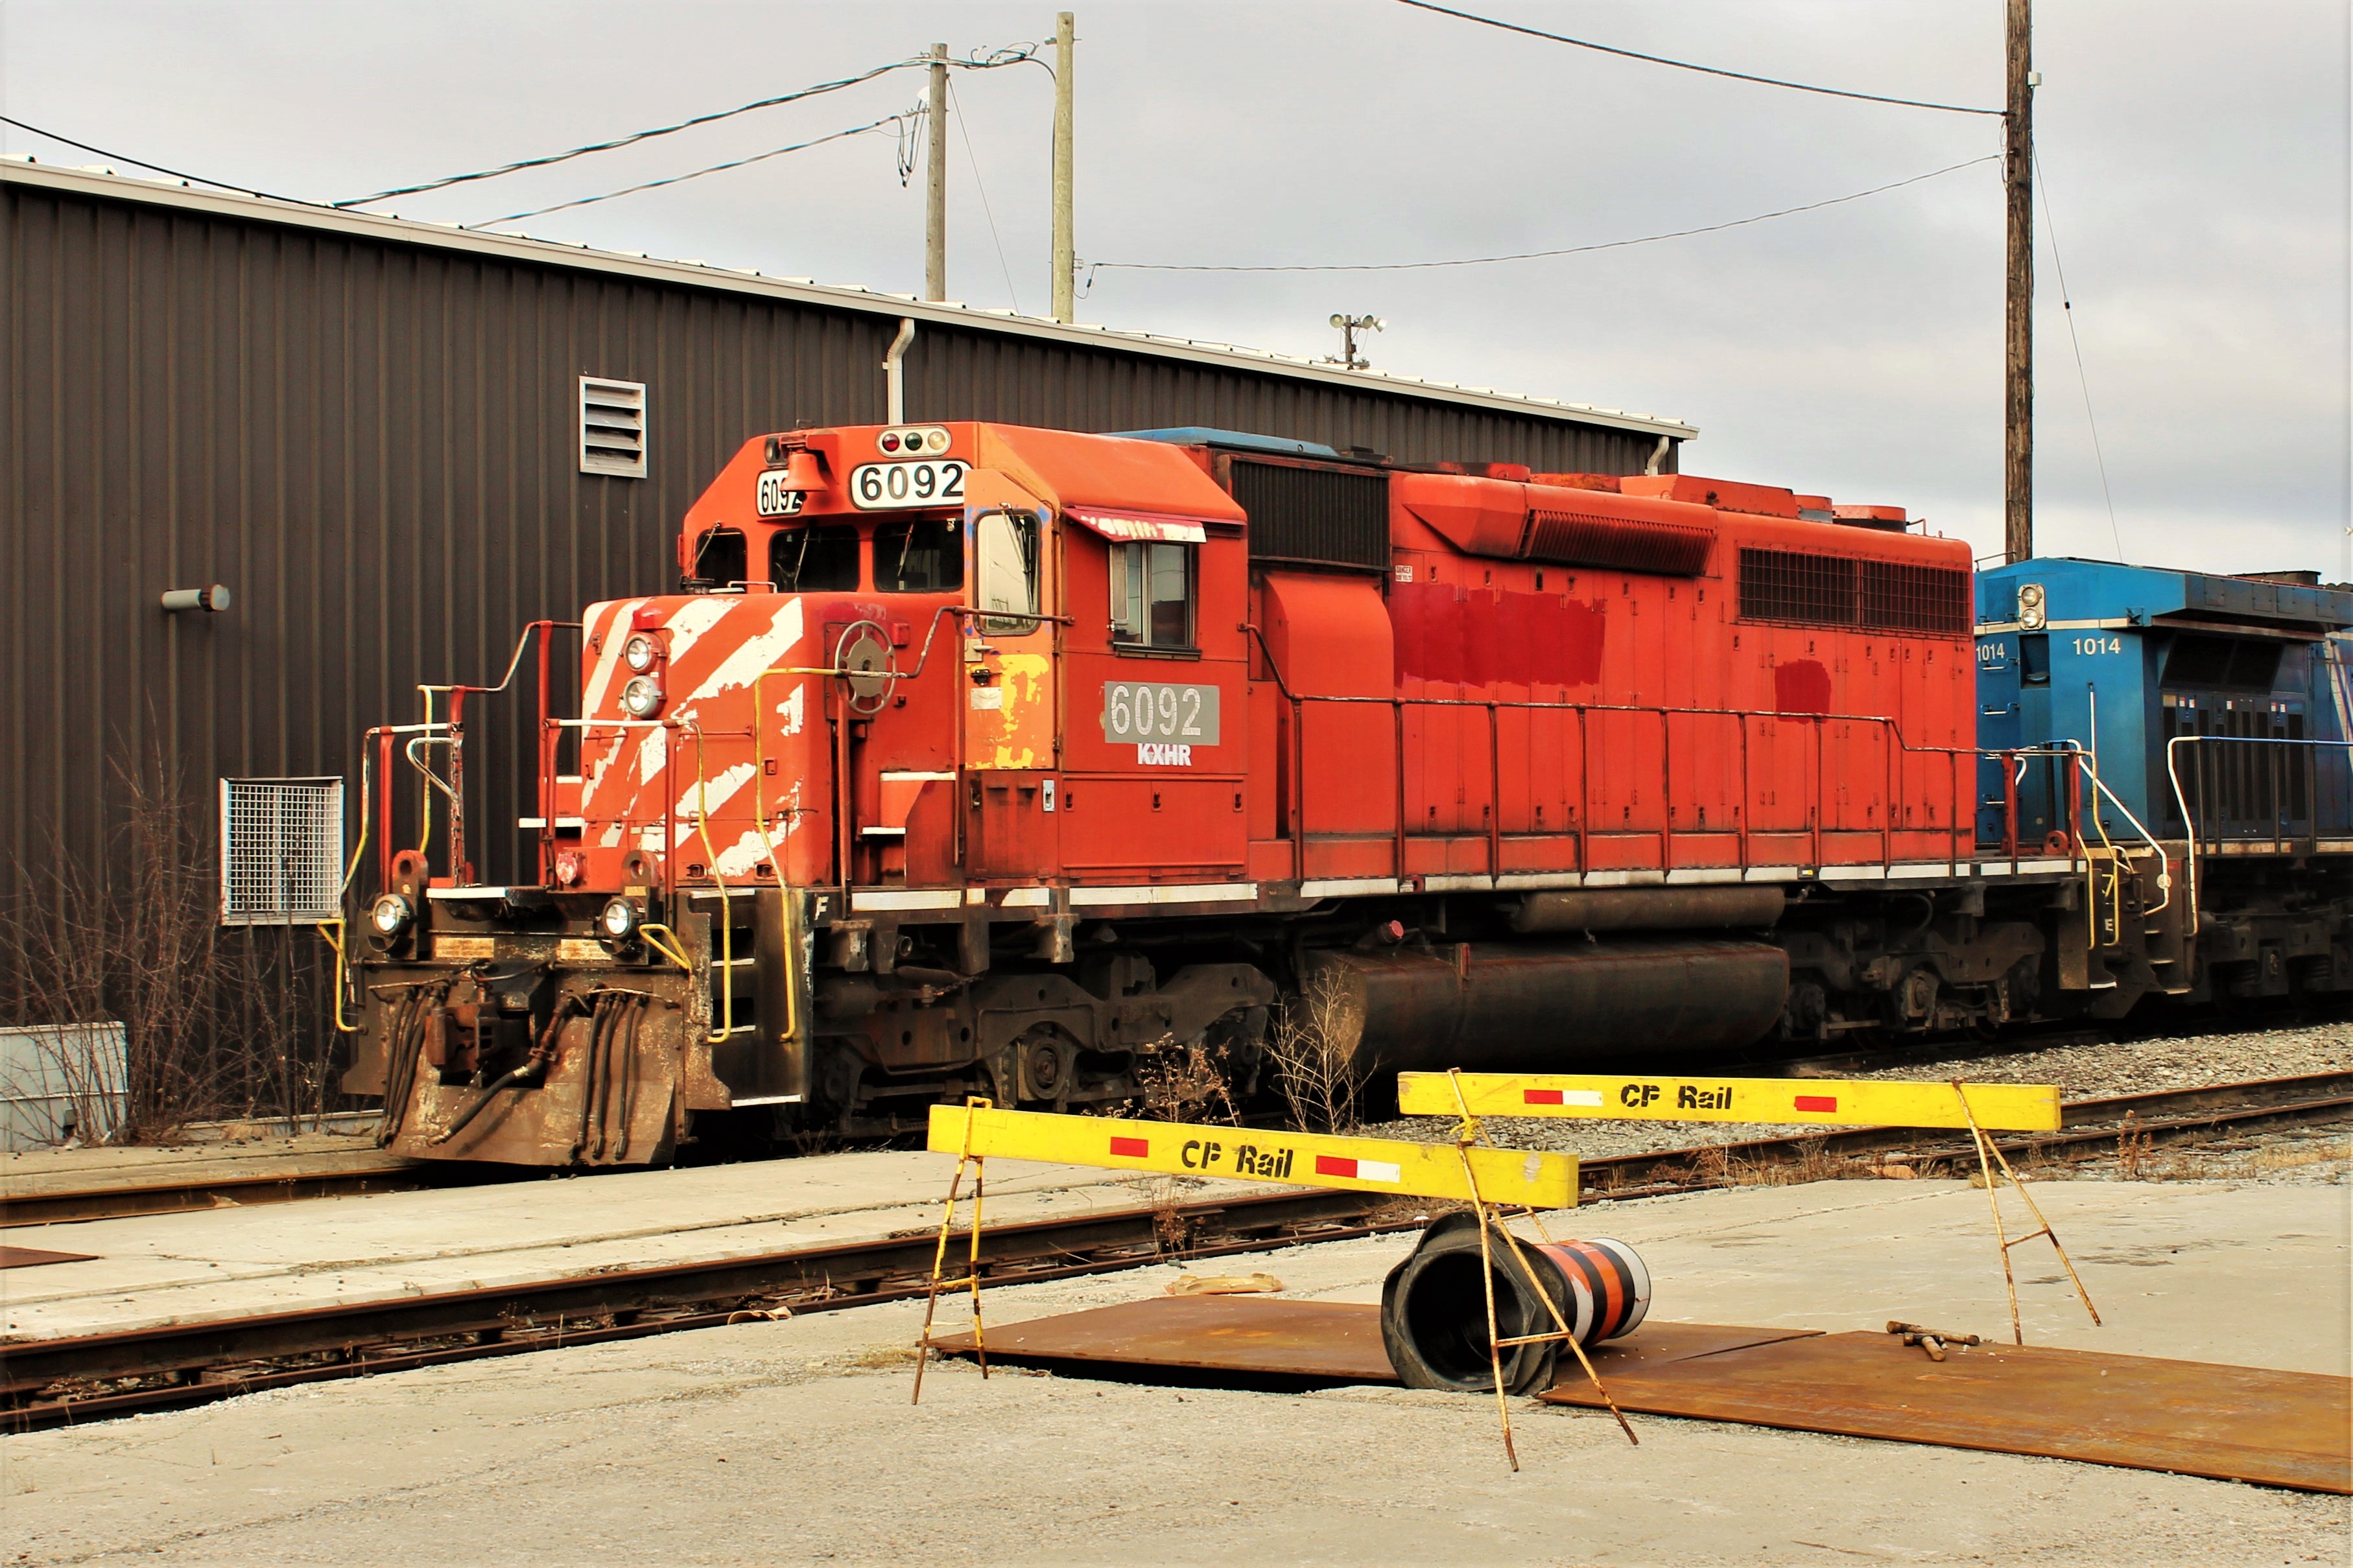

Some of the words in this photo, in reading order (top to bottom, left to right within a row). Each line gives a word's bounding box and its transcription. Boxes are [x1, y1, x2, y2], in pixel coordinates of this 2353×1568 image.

[860, 463, 964, 501] 6092
[1976, 642, 2005, 662] 1014
[2073, 637, 2121, 655] 1014
[1111, 685, 1201, 736] 6092
[1137, 742, 1192, 766] KXHR
[814, 896, 829, 920] F
[1621, 1084, 1660, 1107] CP
[1677, 1085, 1732, 1110] Rail
[1181, 1140, 1222, 1169] CP
[1236, 1145, 1294, 1178] Rail
